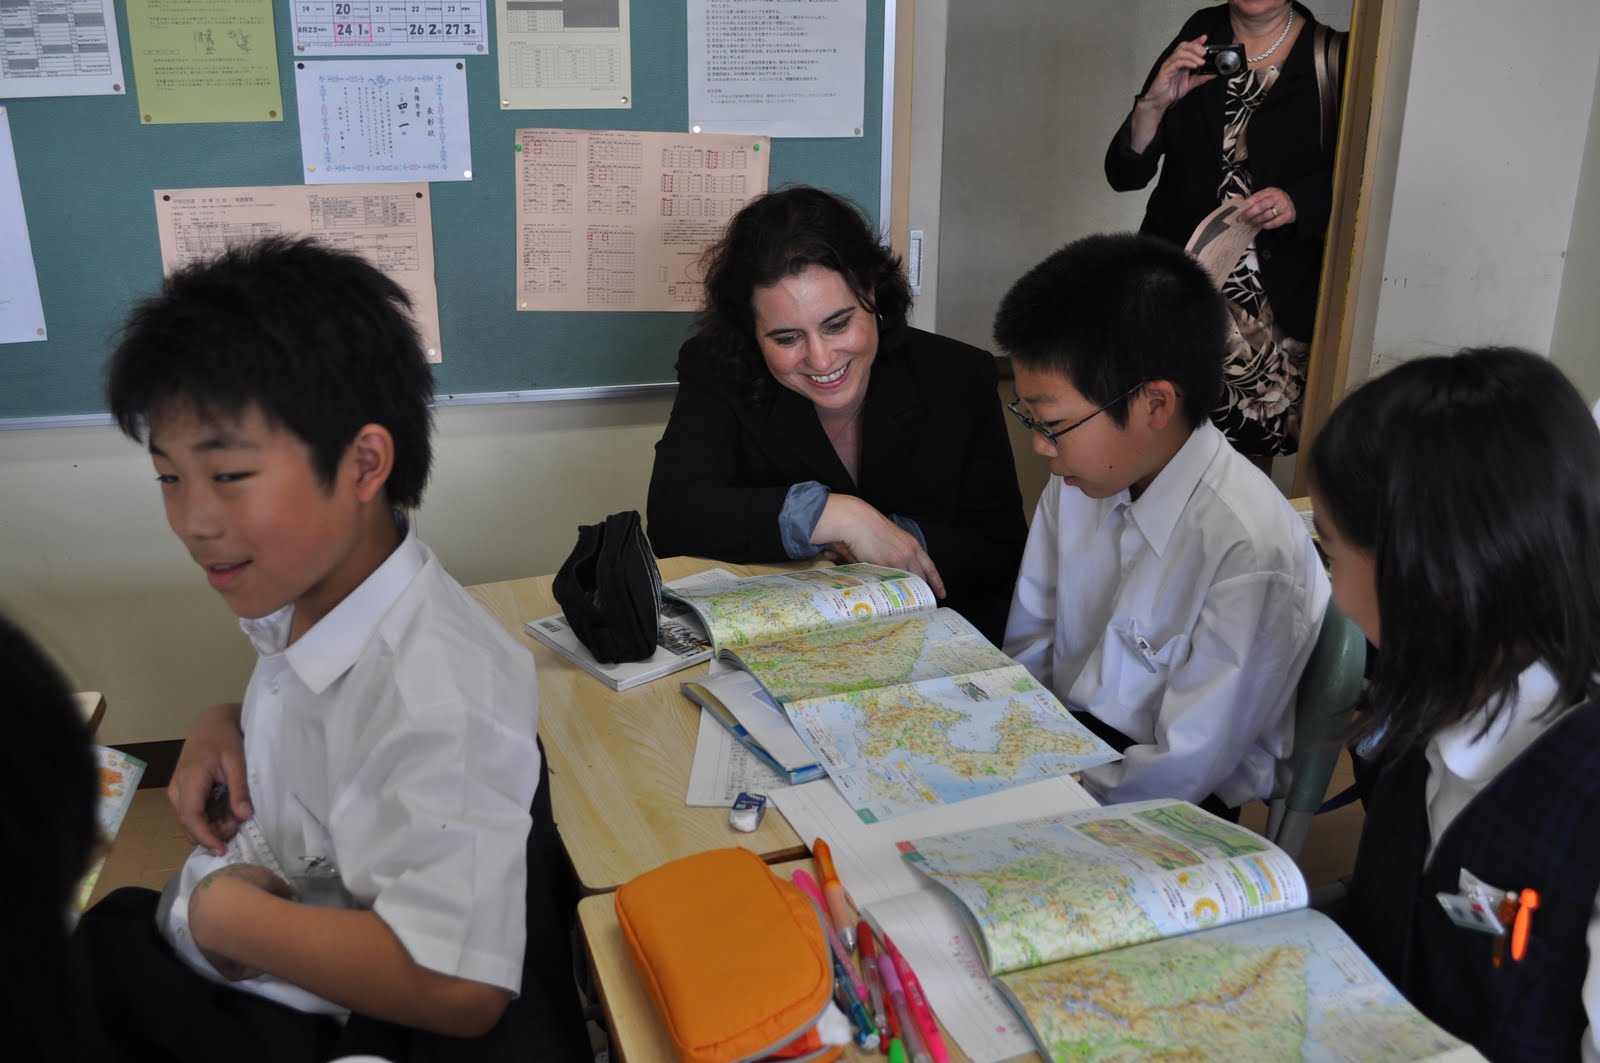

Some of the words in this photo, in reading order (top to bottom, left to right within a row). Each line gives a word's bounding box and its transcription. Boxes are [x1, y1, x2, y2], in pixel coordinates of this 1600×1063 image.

[335, 3, 351, 15] 20
[337, 24, 352, 36] 24
[409, 24, 425, 35] 26
[445, 24, 460, 35] 27
[427, 107, 436, 136] 表彰状
